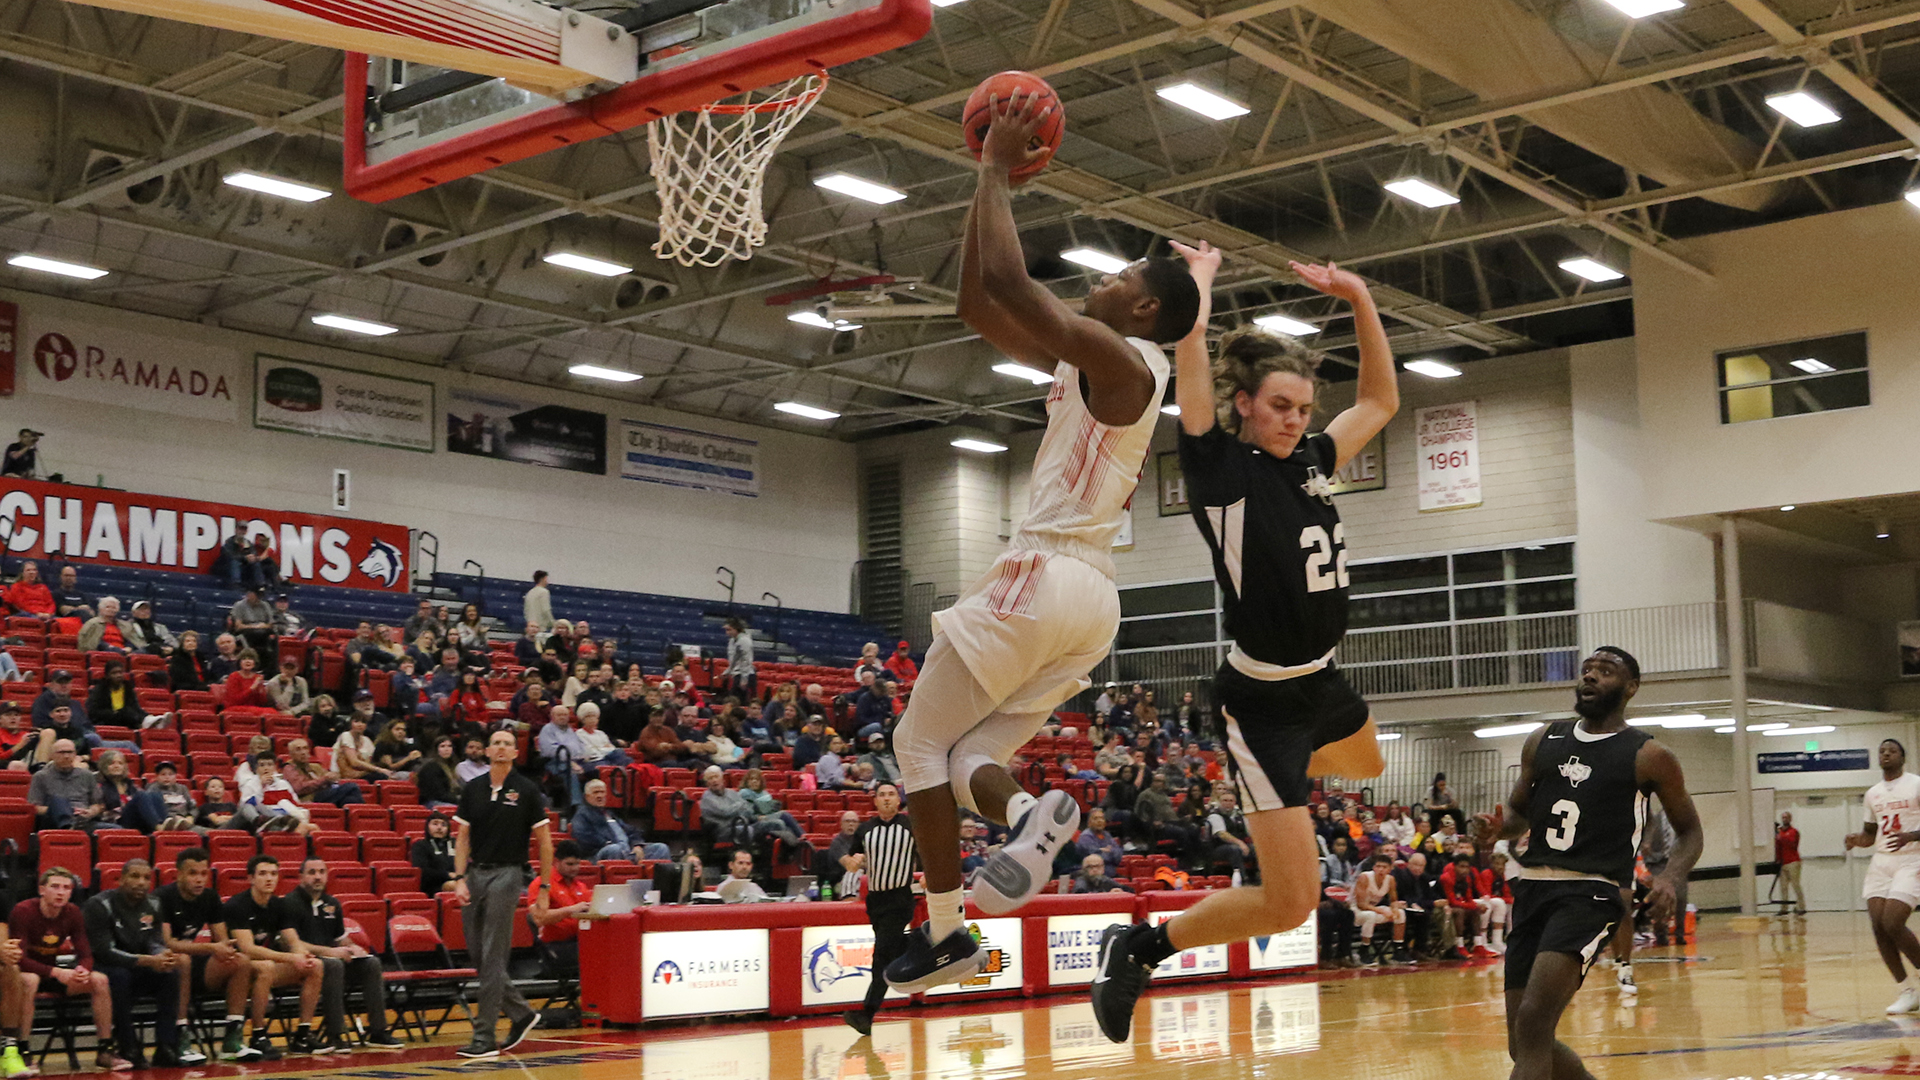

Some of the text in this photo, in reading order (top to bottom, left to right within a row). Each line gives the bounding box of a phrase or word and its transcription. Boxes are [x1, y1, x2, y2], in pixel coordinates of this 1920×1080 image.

[85, 346, 231, 401] RAMADA
[1433, 417, 1475, 433] COLLEGE
[628, 430, 653, 449] The
[1421, 429, 1473, 447] CHAMPIONS
[1427, 450, 1469, 470] 1961
[1299, 522, 1350, 594] 22
[1545, 798, 1581, 851] 3
[1882, 813, 1902, 836] 24
[1049, 929, 1106, 948] DAVE SO
[688, 958, 761, 975] FARMERS
[1055, 951, 1092, 970] PRESS
[688, 978, 738, 989] INSURANCE
